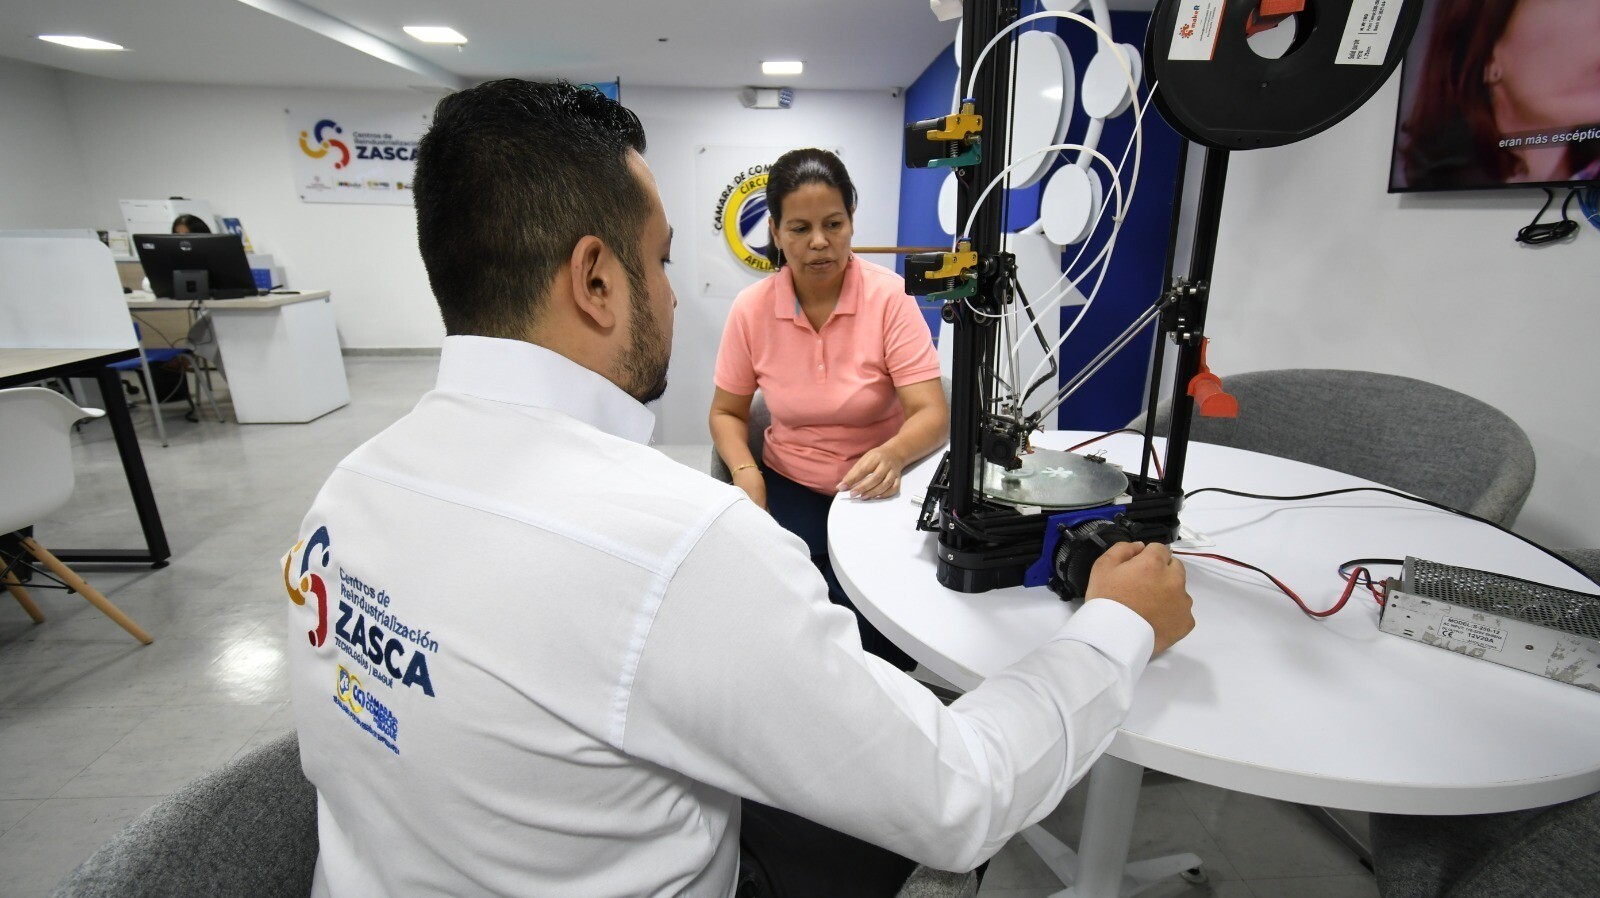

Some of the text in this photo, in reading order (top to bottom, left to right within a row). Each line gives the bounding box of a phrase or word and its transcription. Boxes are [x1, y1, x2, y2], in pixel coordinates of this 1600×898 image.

[1191, 4, 1200, 28] makeR
[353, 131, 381, 139] Centros
[354, 138, 421, 146] Reindustrializació
[1498, 128, 1600, 147] eran más escéptic
[355, 146, 418, 161] ZASCA
[714, 184, 734, 231] CAMARA
[734, 172, 746, 184] DE
[339, 567, 390, 608] Centros de
[341, 583, 439, 654] Reindustrialización
[1468, 632, 1494, 643] 12V20A
[336, 600, 435, 698] ZASCA
